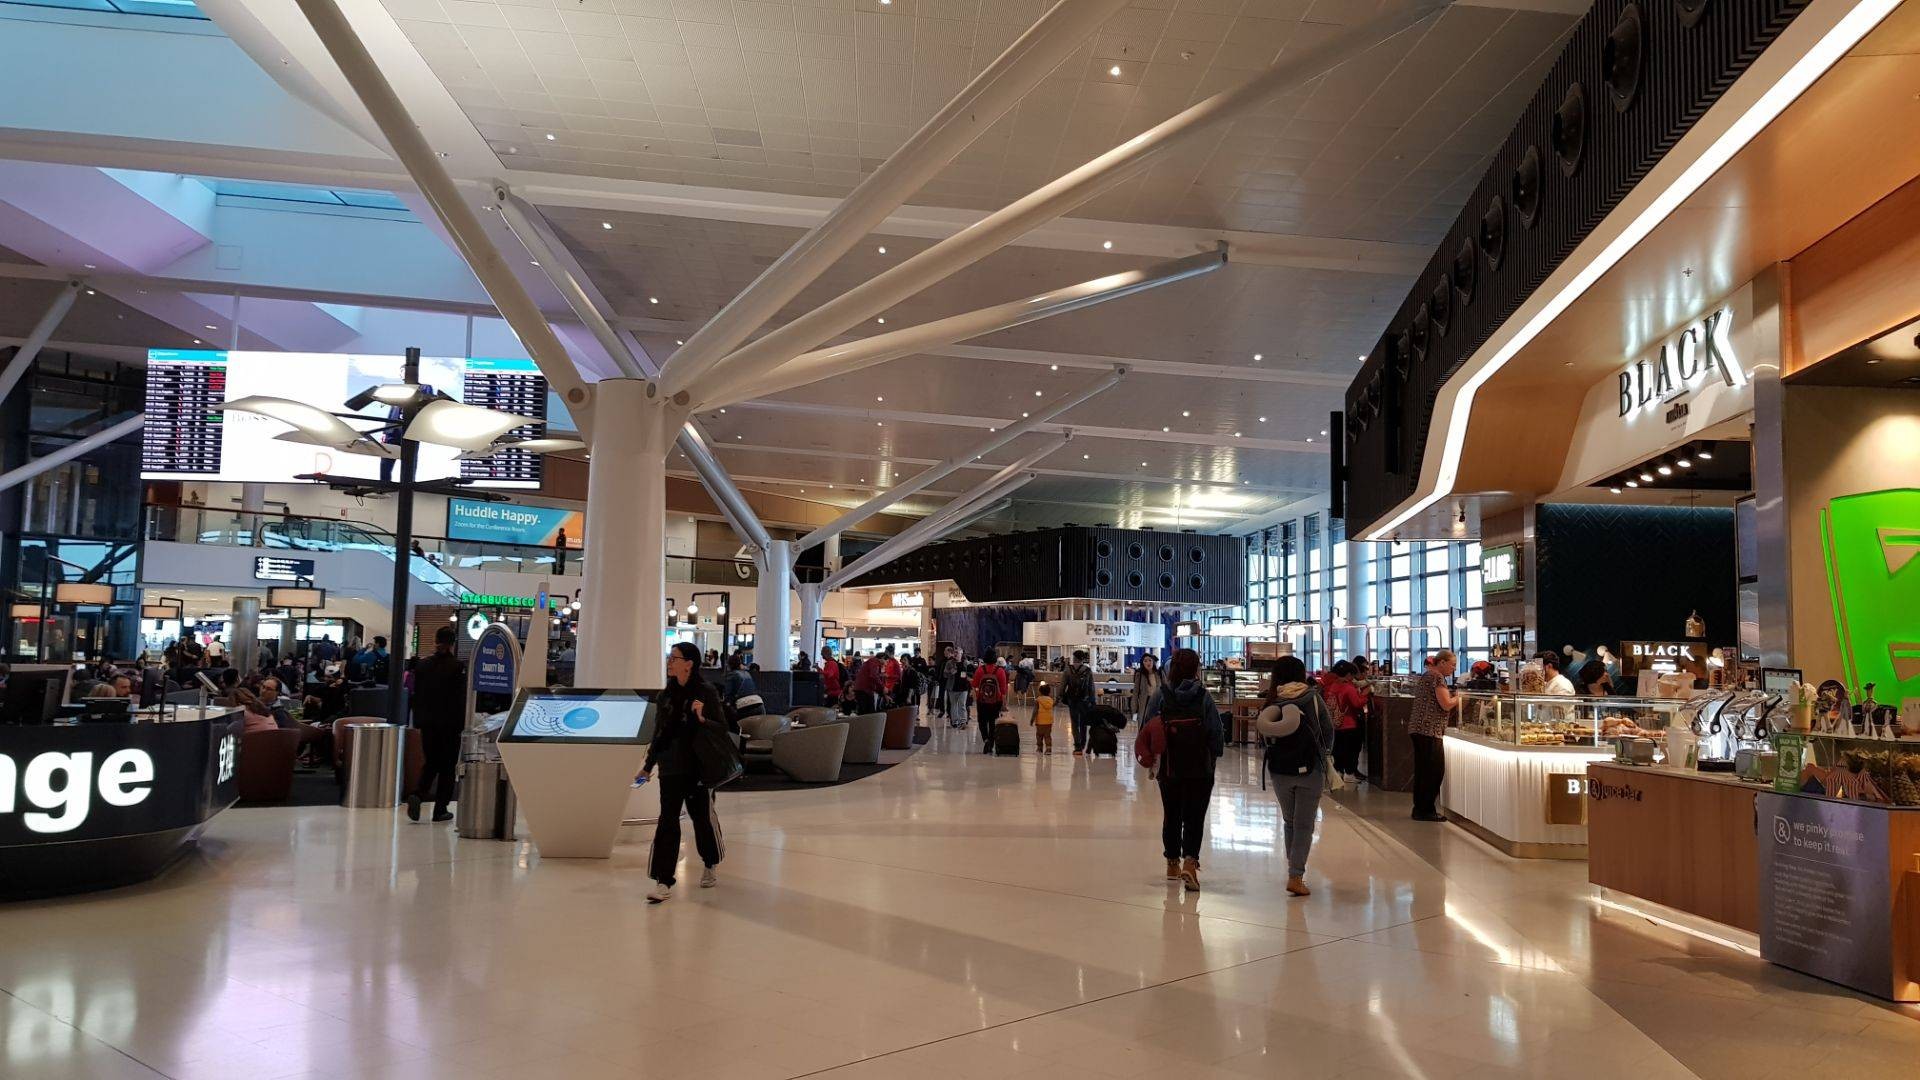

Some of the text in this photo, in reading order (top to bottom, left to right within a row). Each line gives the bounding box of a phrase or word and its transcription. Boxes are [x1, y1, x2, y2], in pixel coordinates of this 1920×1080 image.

[1619, 308, 1736, 418] BLACK
[455, 504, 541, 525] Huddle Happy.
[461, 592, 520, 606] STARBUCKS
[1086, 622, 1130, 636] PERONI
[1632, 644, 1695, 661] BLACK
[1793, 822, 1805, 832] we
[1806, 822, 1828, 838] pinky
[1794, 836, 1802, 847] to
[1804, 837, 1823, 853] keep
